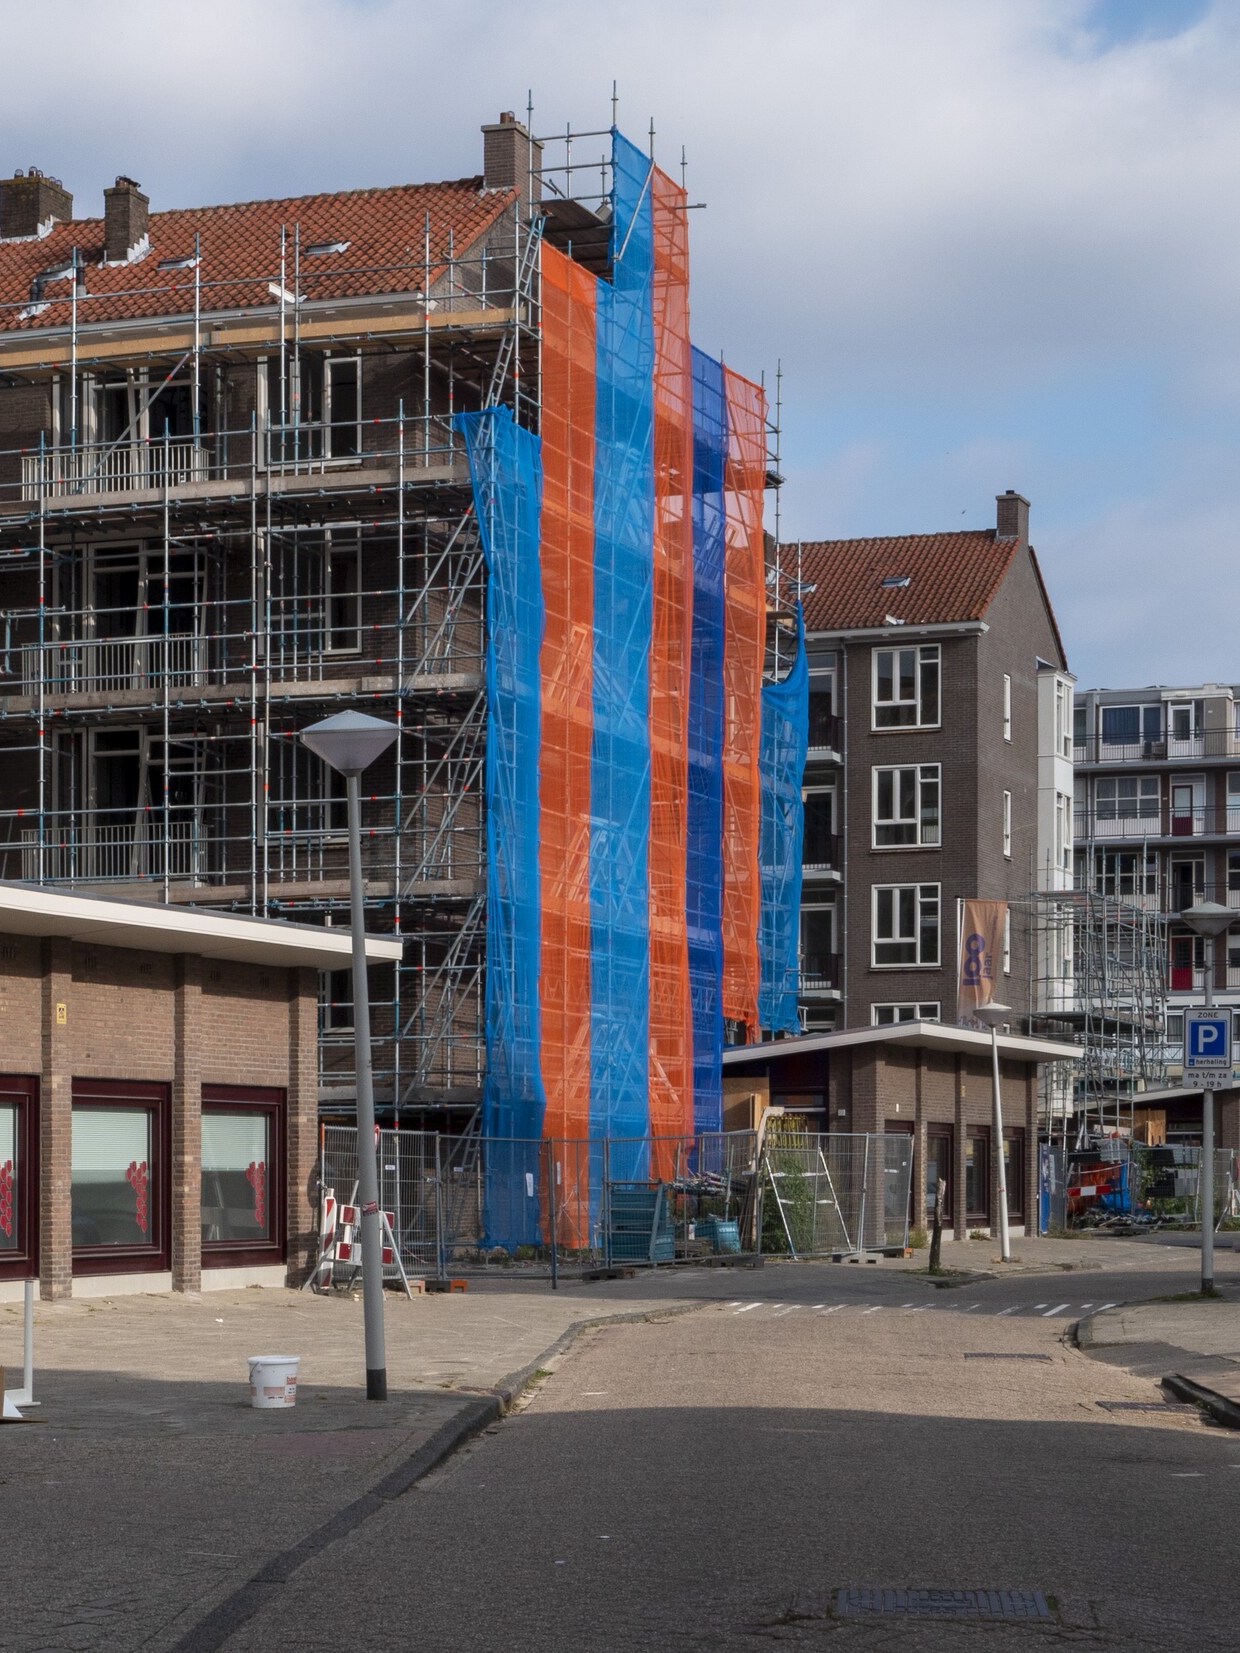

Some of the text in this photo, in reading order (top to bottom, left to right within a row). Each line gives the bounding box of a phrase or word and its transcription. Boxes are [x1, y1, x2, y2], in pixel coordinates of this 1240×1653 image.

[982, 952, 994, 980] jaar
[1198, 1025, 1219, 1053] P
[1195, 1059, 1227, 1067] herhaling
[1202, 1071, 1216, 1079] t/m
